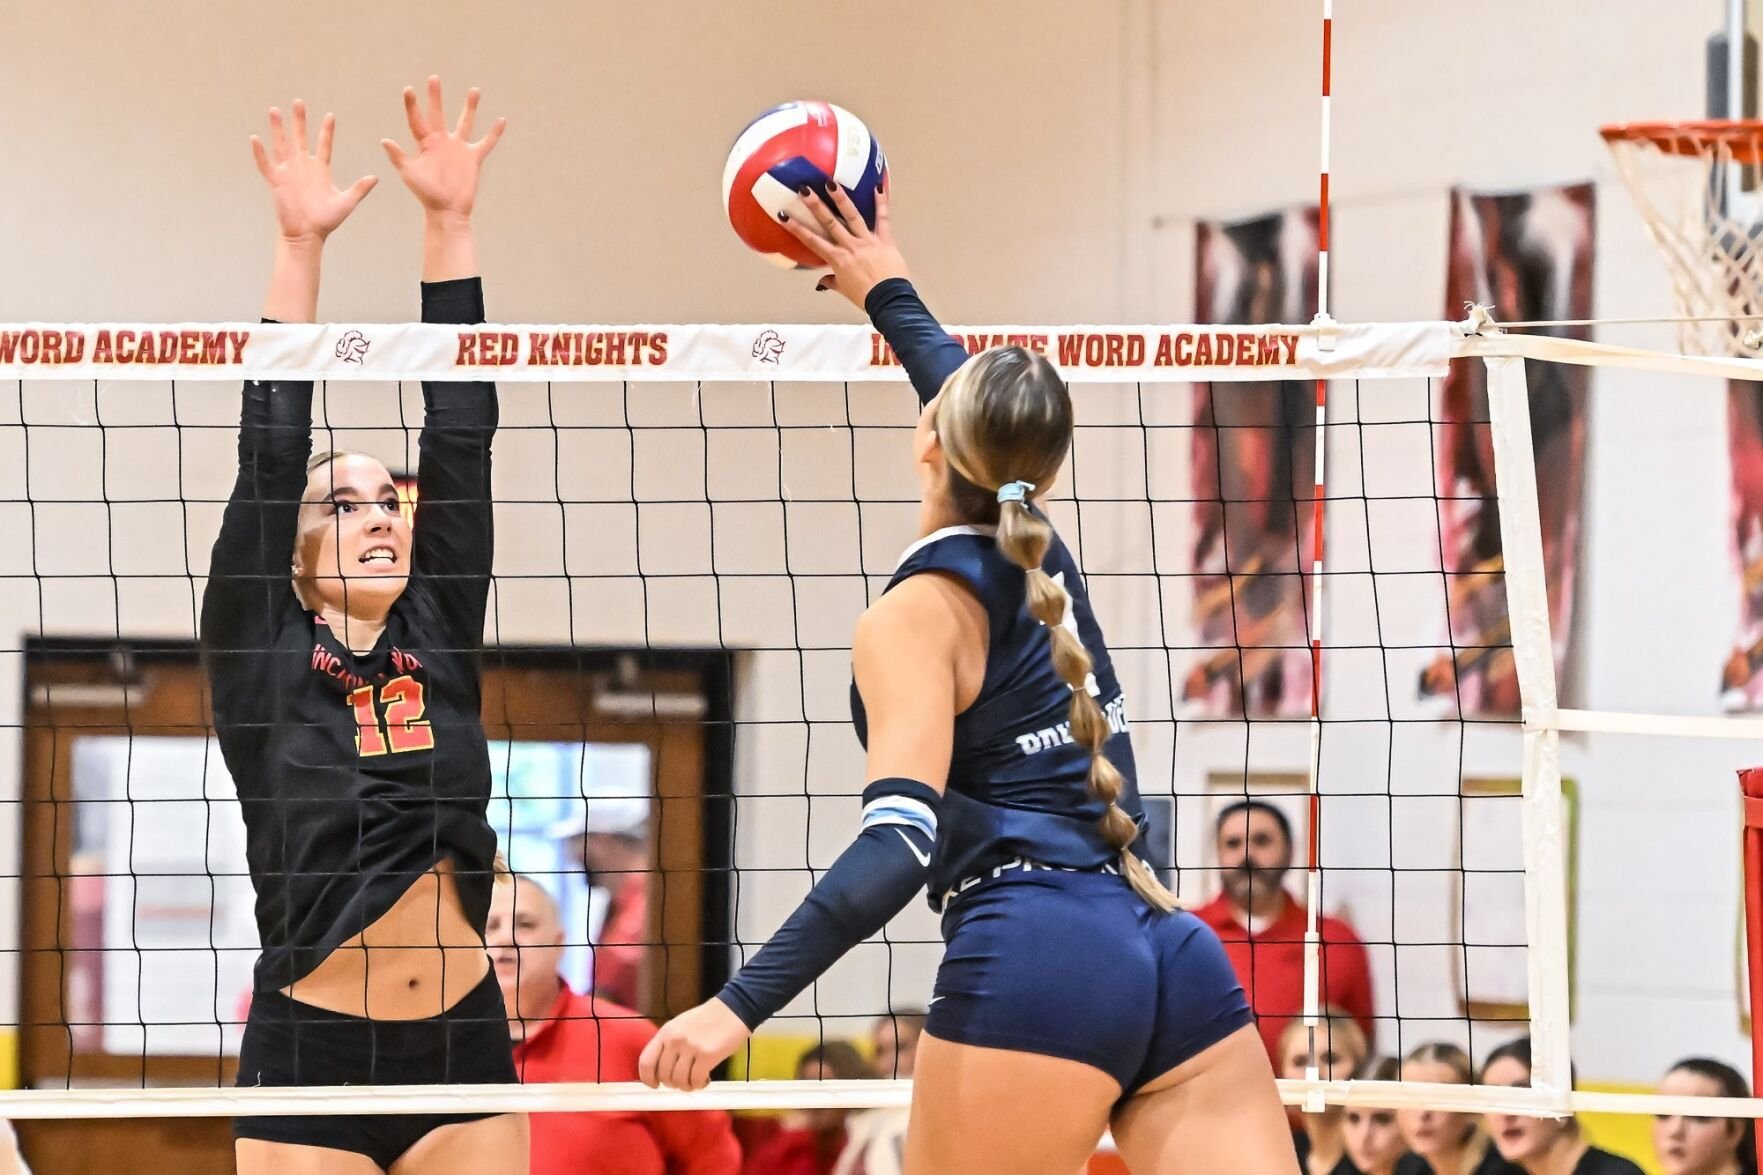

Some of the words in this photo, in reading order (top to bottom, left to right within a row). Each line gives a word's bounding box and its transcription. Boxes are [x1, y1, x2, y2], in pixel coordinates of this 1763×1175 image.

[0, 330, 85, 364] WORD
[92, 330, 250, 364] ACADEMY
[456, 332, 519, 366] RED
[527, 332, 668, 366] KNIGHTS
[1058, 334, 1145, 367] WORD
[1154, 333, 1300, 367] ACADEMY
[346, 675, 435, 757] 12
